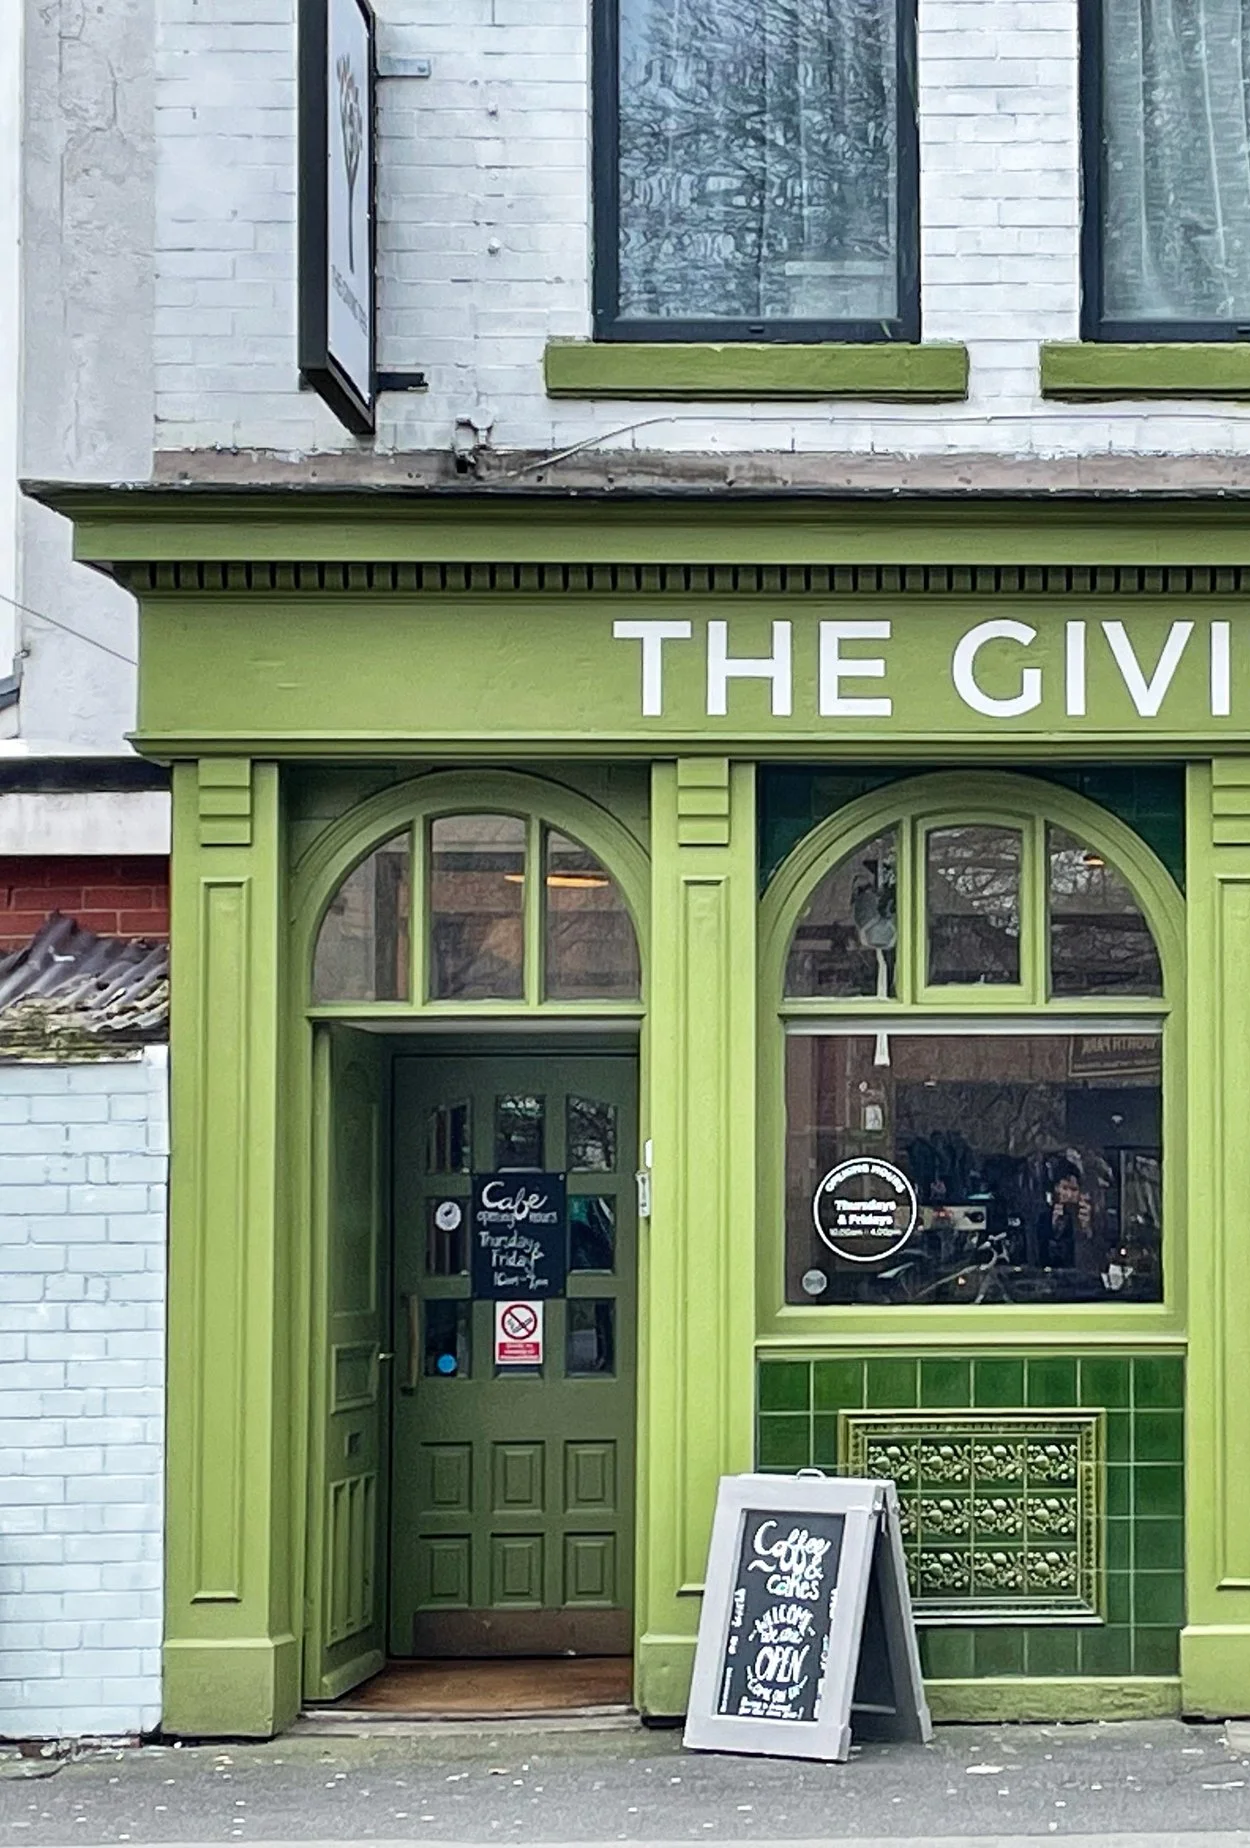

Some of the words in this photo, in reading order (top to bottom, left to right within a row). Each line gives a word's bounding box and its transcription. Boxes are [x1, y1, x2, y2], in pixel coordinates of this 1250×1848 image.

[613, 619, 892, 717] THE
[870, 1165, 906, 1193] HOURS
[837, 1214, 847, 1225] &
[848, 1213, 894, 1226] Fridays
[478, 1229, 534, 1253] Thursday
[491, 1248, 535, 1274] Friday
[754, 1520, 832, 1573] Coffee
[804, 1563, 824, 1580] &
[755, 1644, 811, 1684] OPEN
